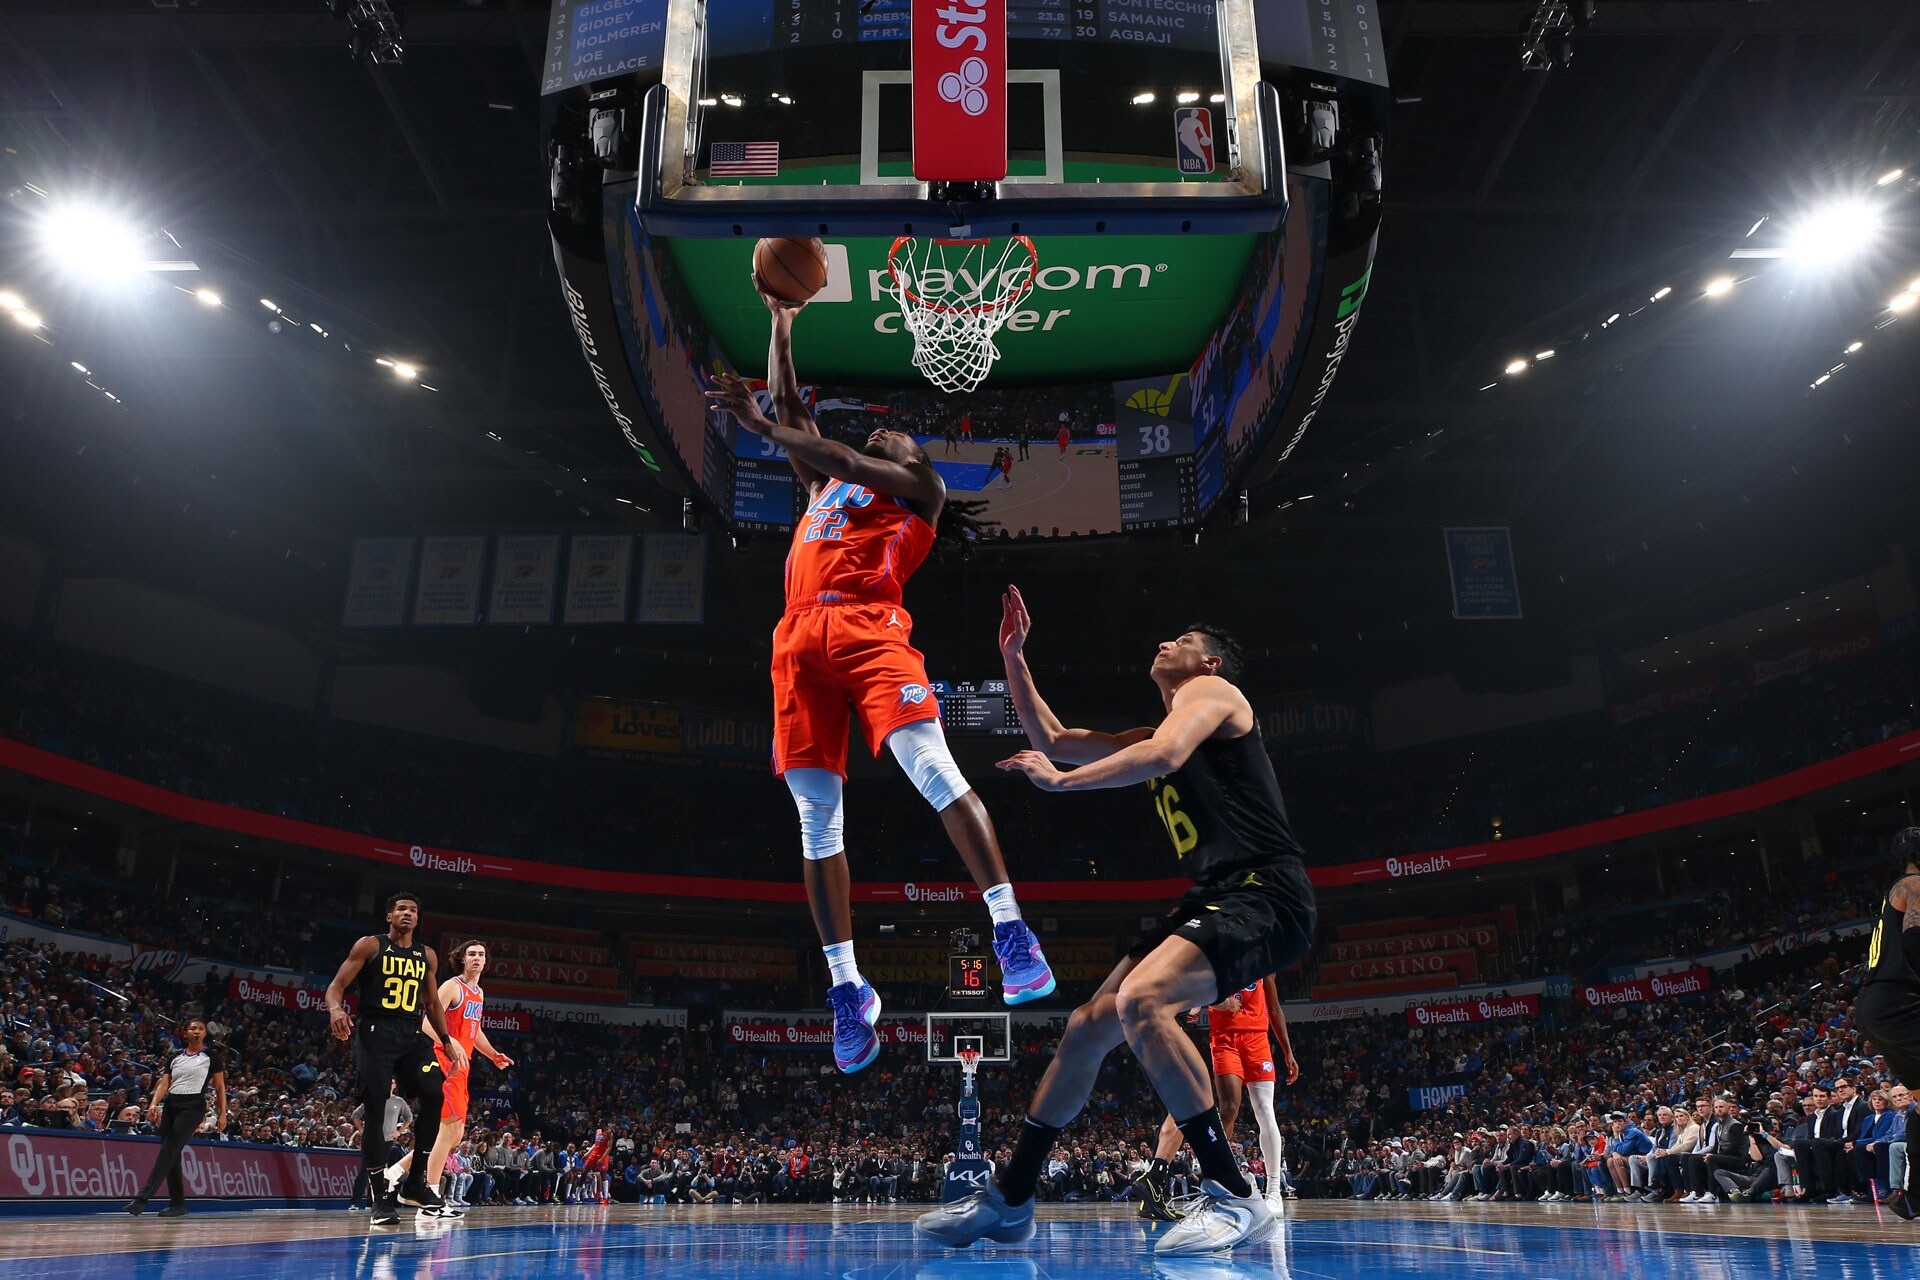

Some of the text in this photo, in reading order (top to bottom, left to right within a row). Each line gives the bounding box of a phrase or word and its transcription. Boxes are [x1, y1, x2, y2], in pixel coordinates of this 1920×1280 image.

[558, 15, 566, 25] 2
[1037, 9, 1186, 28] 23.8 19 SAMANIC
[1323, 11, 1331, 21] 5
[556, 11, 634, 40] 3 GIDDEY
[863, 30, 879, 38] FT
[1321, 26, 1336, 38] 13
[554, 21, 661, 56] 7 HOLMGREN
[791, 33, 800, 43] 2
[1042, 26, 1172, 44] 7.7 30 AGBAJI
[1327, 43, 1336, 54] 2
[551, 50, 603, 72] 11 JOE
[1329, 60, 1338, 70] 2
[545, 56, 647, 90] 22 WALLACE
[1183, 158, 1201, 170] NBA
[1312, 312, 1357, 406] paycom
[1139, 425, 1170, 455] 38
[1120, 473, 1146, 481] CLARKSON
[803, 510, 848, 543] 22
[988, 683, 1004, 692] 38
[410, 846, 477, 873] OU Health
[1385, 855, 1451, 878] OU Health
[904, 882, 964, 902] OU Health
[1337, 930, 1492, 961] RIVERWIND
[382, 955, 426, 980] UTAH
[961, 959, 982, 969] 5:16
[1351, 955, 1445, 978] CASINO
[494, 962, 589, 984] CASINO
[964, 970, 980, 987] 16
[239, 980, 286, 1007] OU Health
[382, 977, 419, 1012] 30
[1651, 975, 1701, 997] OU Health
[1585, 986, 1643, 1006] OU Health
[311, 998, 351, 1014] Heh
[1313, 1004, 1343, 1018] Bally
[1479, 1001, 1529, 1018] OU Health
[481, 1016, 520, 1031] Health
[666, 1014, 685, 1026] 119
[1416, 1007, 1470, 1024] OU Health
[733, 1025, 780, 1042] OU Health
[787, 1027, 799, 1042] OU
[896, 1027, 908, 1041] OU
[908, 1030, 944, 1043] Heath
[965, 1140, 974, 1151] OU
[958, 1152, 981, 1160] Health
[8, 1134, 140, 1197] OU Health
[181, 1144, 273, 1196] OU Health
[299, 1152, 319, 1195] OU
